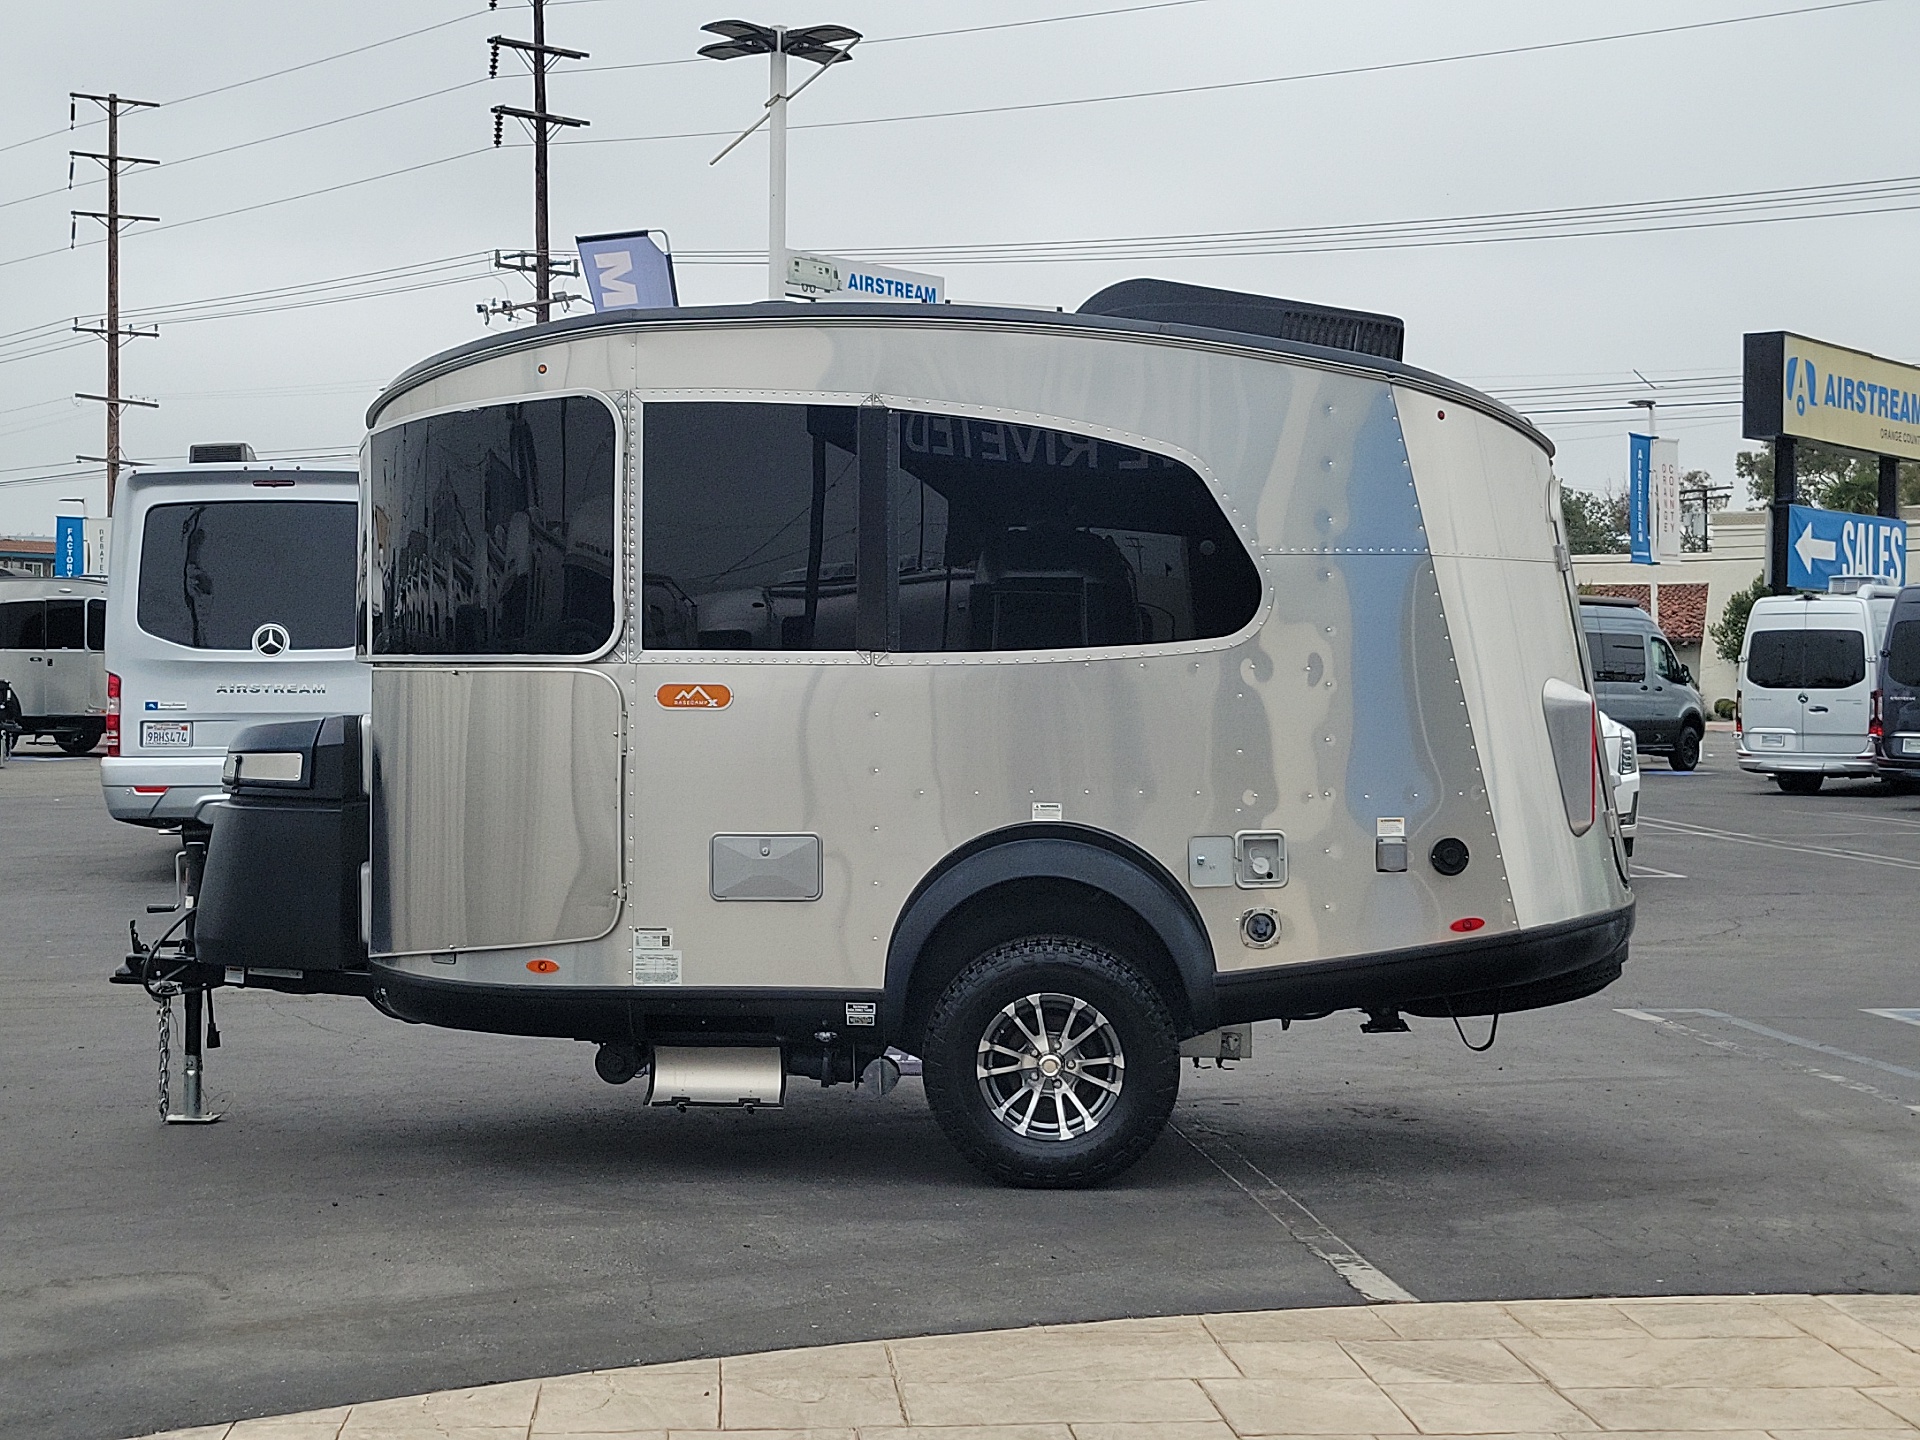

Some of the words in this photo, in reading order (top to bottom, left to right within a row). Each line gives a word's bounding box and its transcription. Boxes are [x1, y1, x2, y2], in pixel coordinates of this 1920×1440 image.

[848, 265, 937, 304] AIRSTREAM
[66, 527, 74, 578] FACTORY
[1841, 520, 1903, 588] SALES
[216, 683, 326, 694] AIRSTREAM
